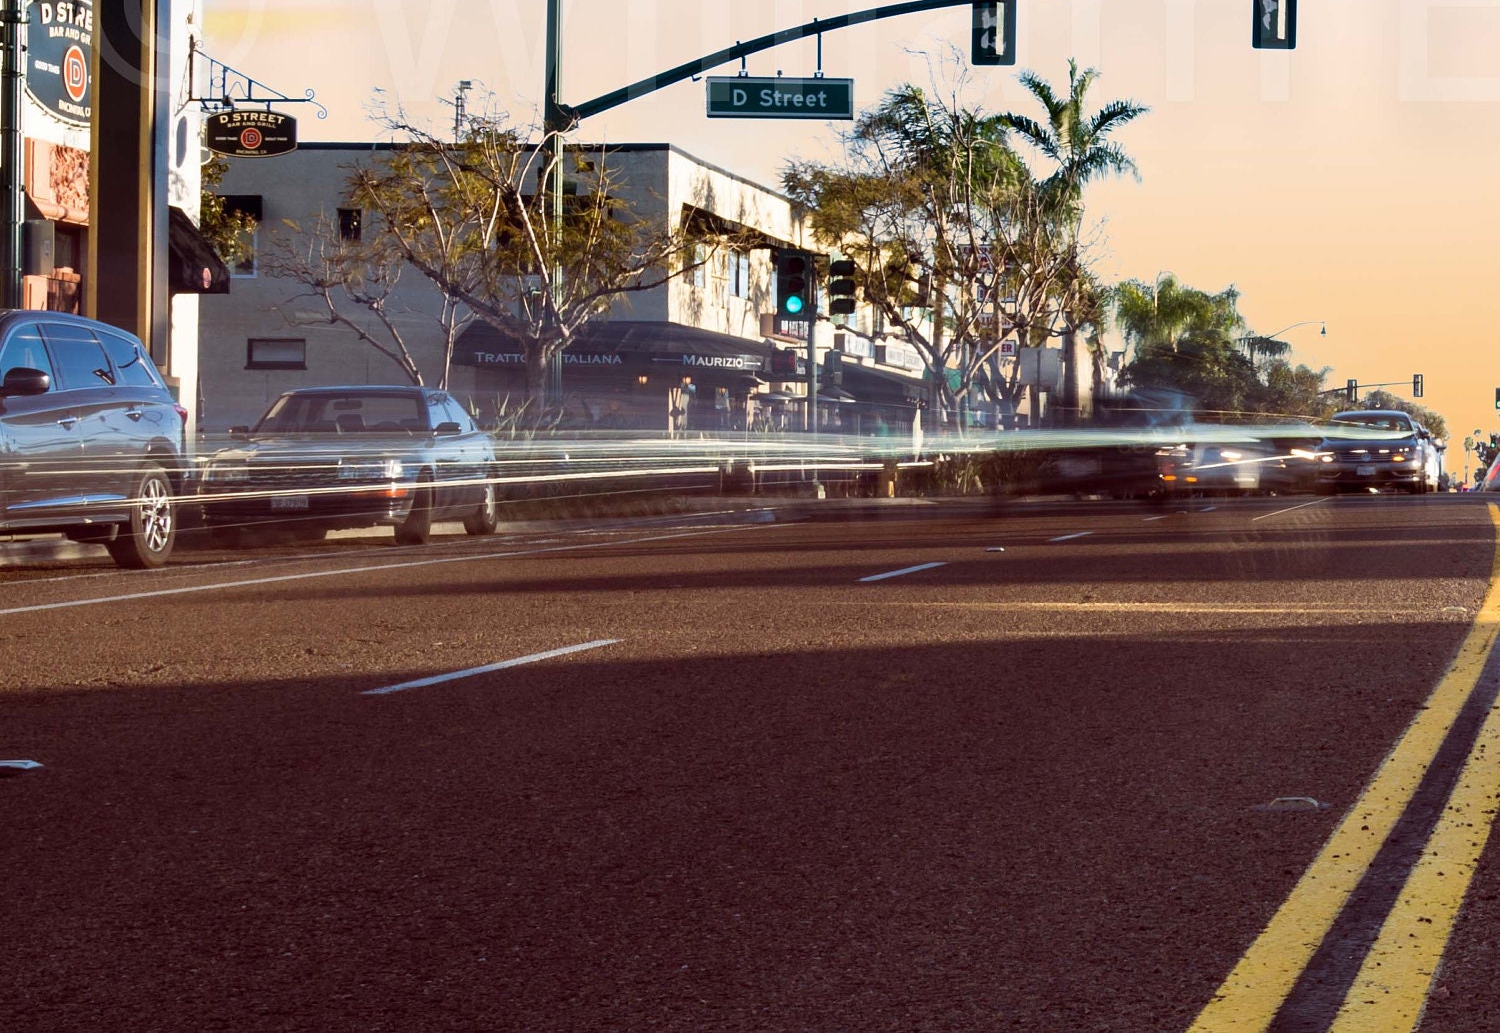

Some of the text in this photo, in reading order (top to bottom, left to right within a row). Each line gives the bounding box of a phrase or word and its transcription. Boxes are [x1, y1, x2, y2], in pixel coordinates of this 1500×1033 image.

[41, 1, 92, 31] D STRE
[49, 26, 64, 38] BAR
[65, 27, 80, 40] AND
[733, 89, 827, 107] D Street
[220, 113, 285, 124] D STREET
[562, 353, 623, 364] TALIANA
[682, 354, 743, 368] MAURIZIO
